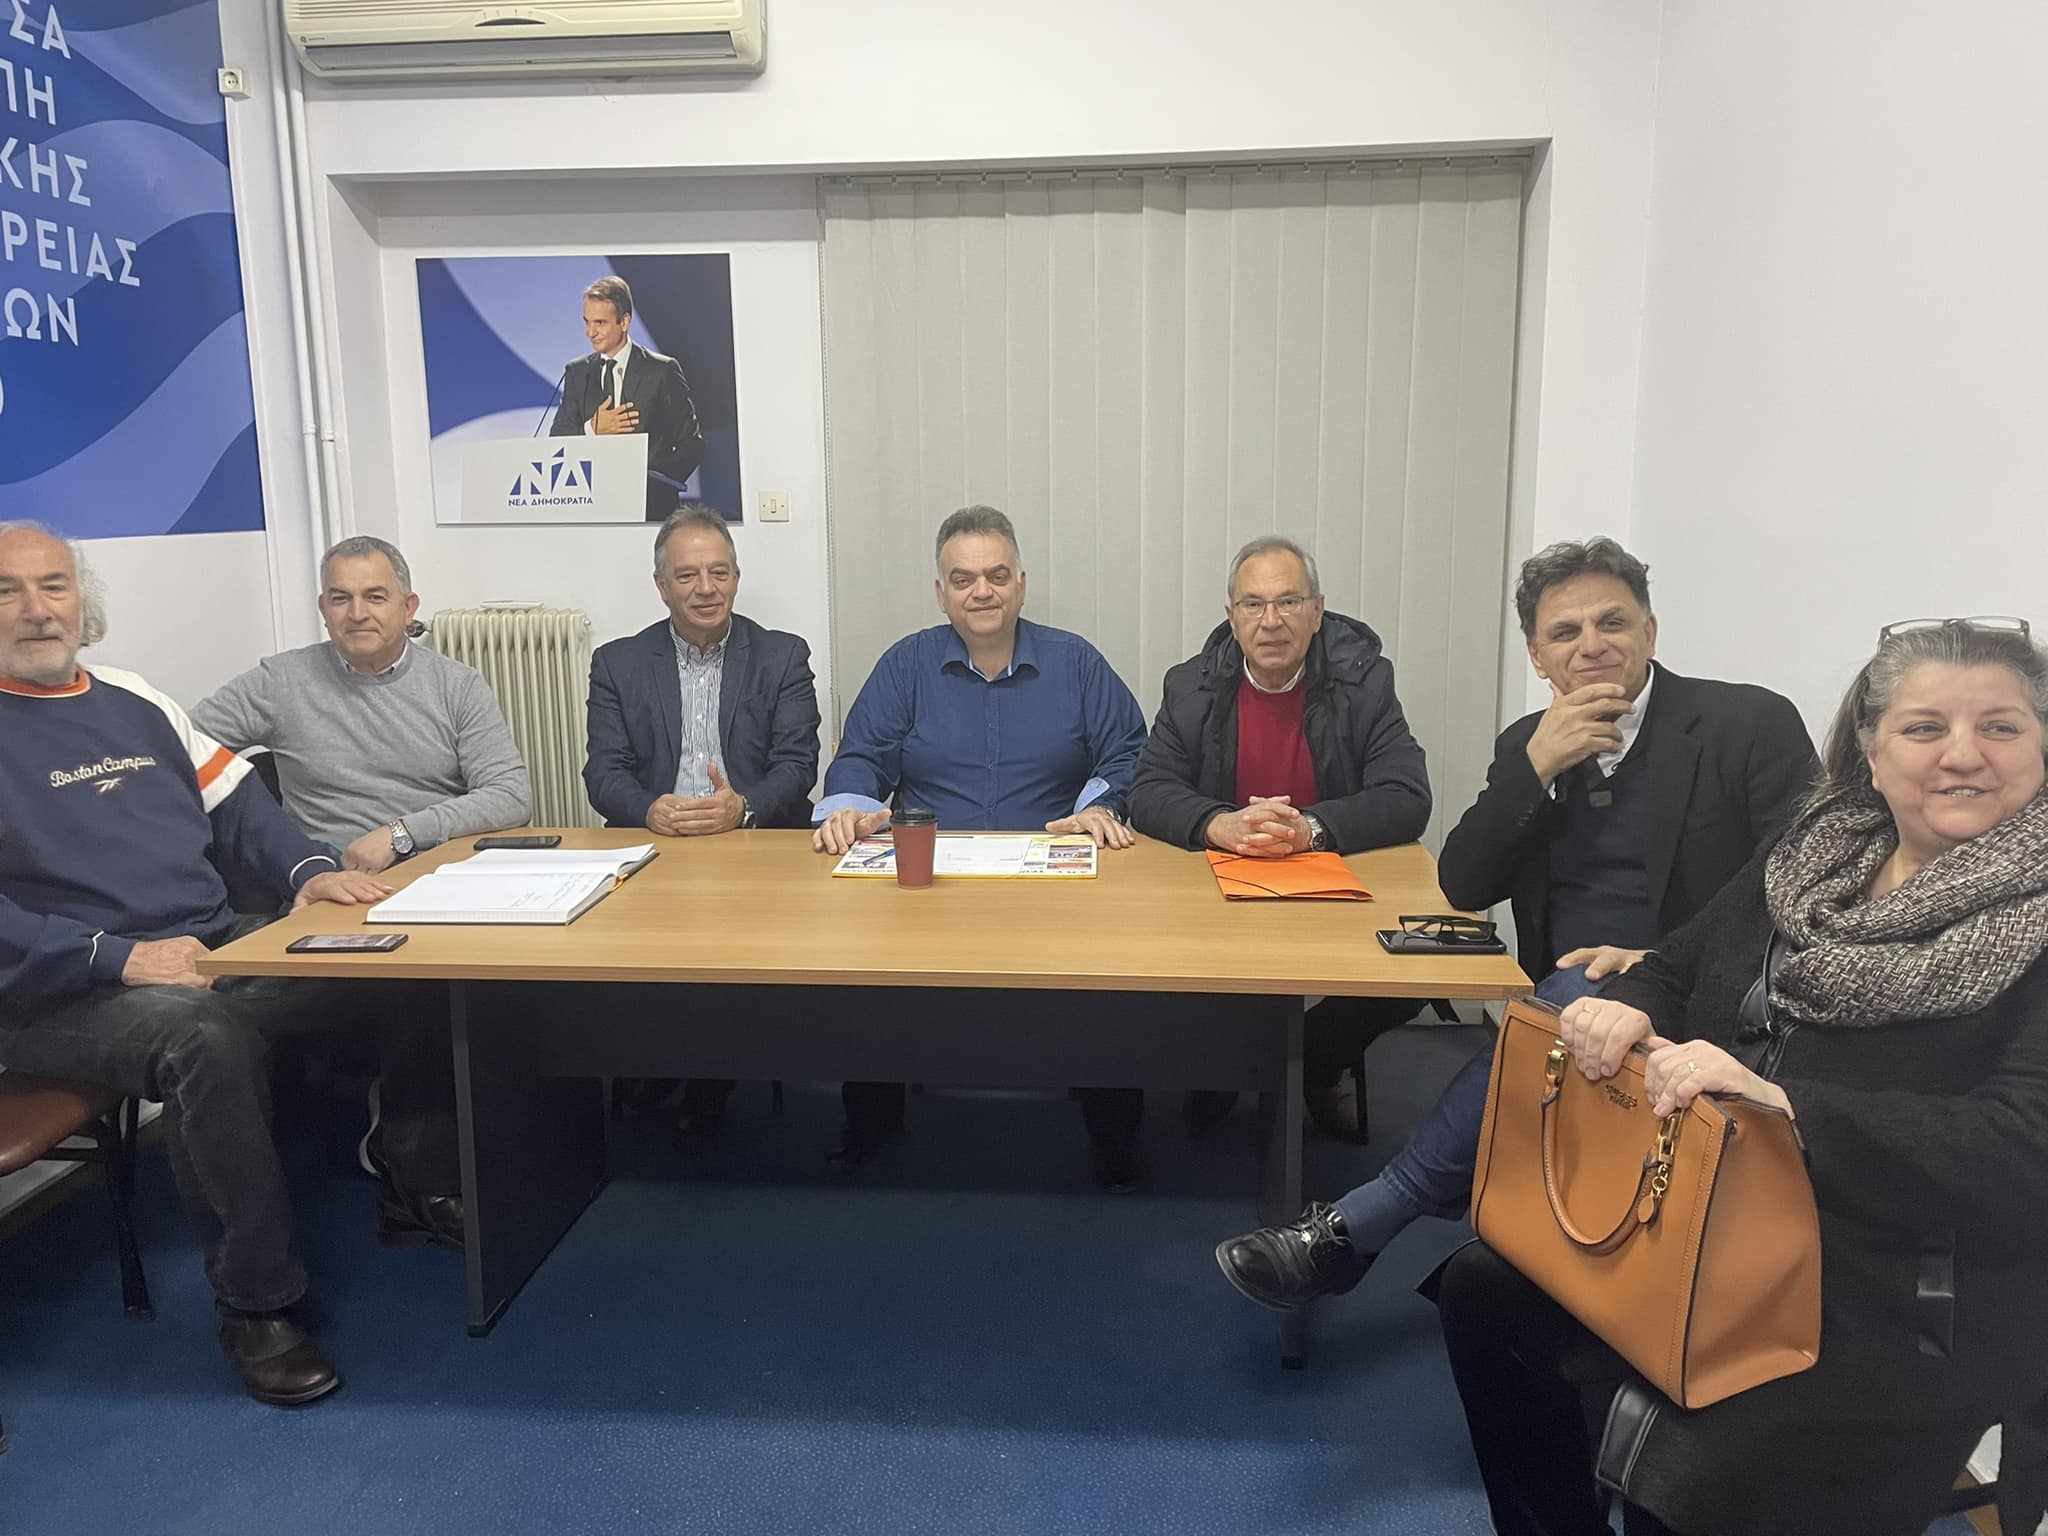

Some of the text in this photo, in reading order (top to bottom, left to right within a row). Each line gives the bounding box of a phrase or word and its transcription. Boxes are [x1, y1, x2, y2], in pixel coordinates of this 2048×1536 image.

[1, 210, 142, 288] ΡΕΙΑΣ
[4, 287, 79, 347] ΩΝ
[508, 496, 594, 507] ΝΕΑ ΔΗΜΟΚΡΑΤΙΑ
